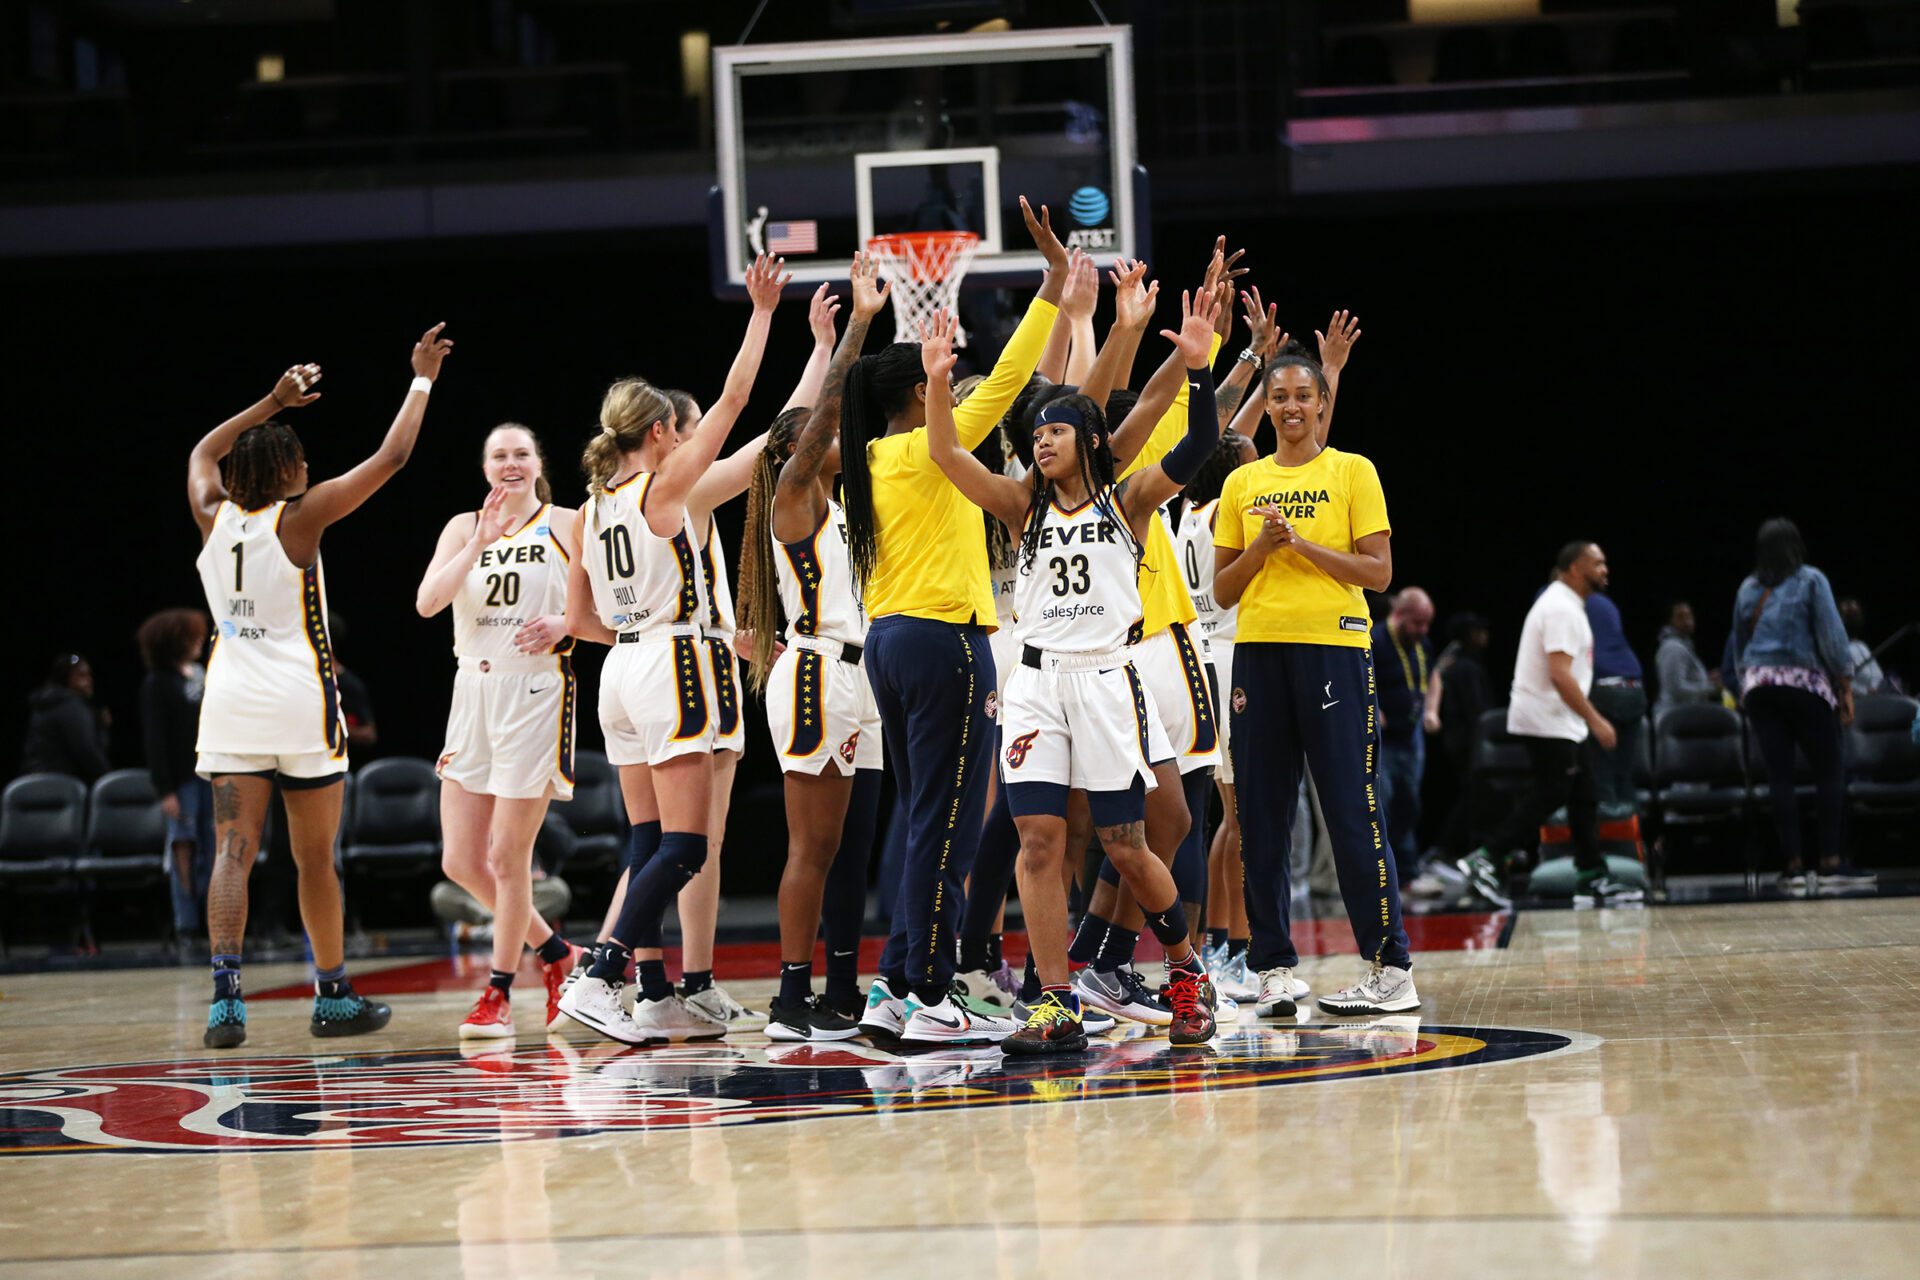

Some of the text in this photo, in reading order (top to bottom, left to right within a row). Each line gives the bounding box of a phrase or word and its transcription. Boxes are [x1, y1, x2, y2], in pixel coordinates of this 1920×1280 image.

[1066, 229, 1115, 249] AT&T
[1254, 489, 1330, 507] INDIANA
[1276, 505, 1316, 519] VER
[1034, 520, 1117, 550] EVER
[231, 541, 245, 592] 1
[479, 544, 546, 568] EVER
[599, 524, 636, 582] 10
[485, 571, 521, 607] 20
[1049, 553, 1092, 597] 33
[475, 615, 525, 627] salesorce
[1042, 604, 1105, 621] salesforce
[1367, 666, 1376, 695] WNBA
[1367, 704, 1375, 734] WNBA
[955, 756, 966, 788] WNBA
[1365, 744, 1374, 774] WNBA
[1365, 783, 1377, 812] WNBA
[948, 797, 960, 829] WNBA
[1370, 821, 1382, 850] WNBA
[1377, 858, 1388, 888] WNBA
[934, 881, 943, 912] WNBA
[1380, 897, 1390, 927] WNBA
[928, 923, 939, 955] WNBA
